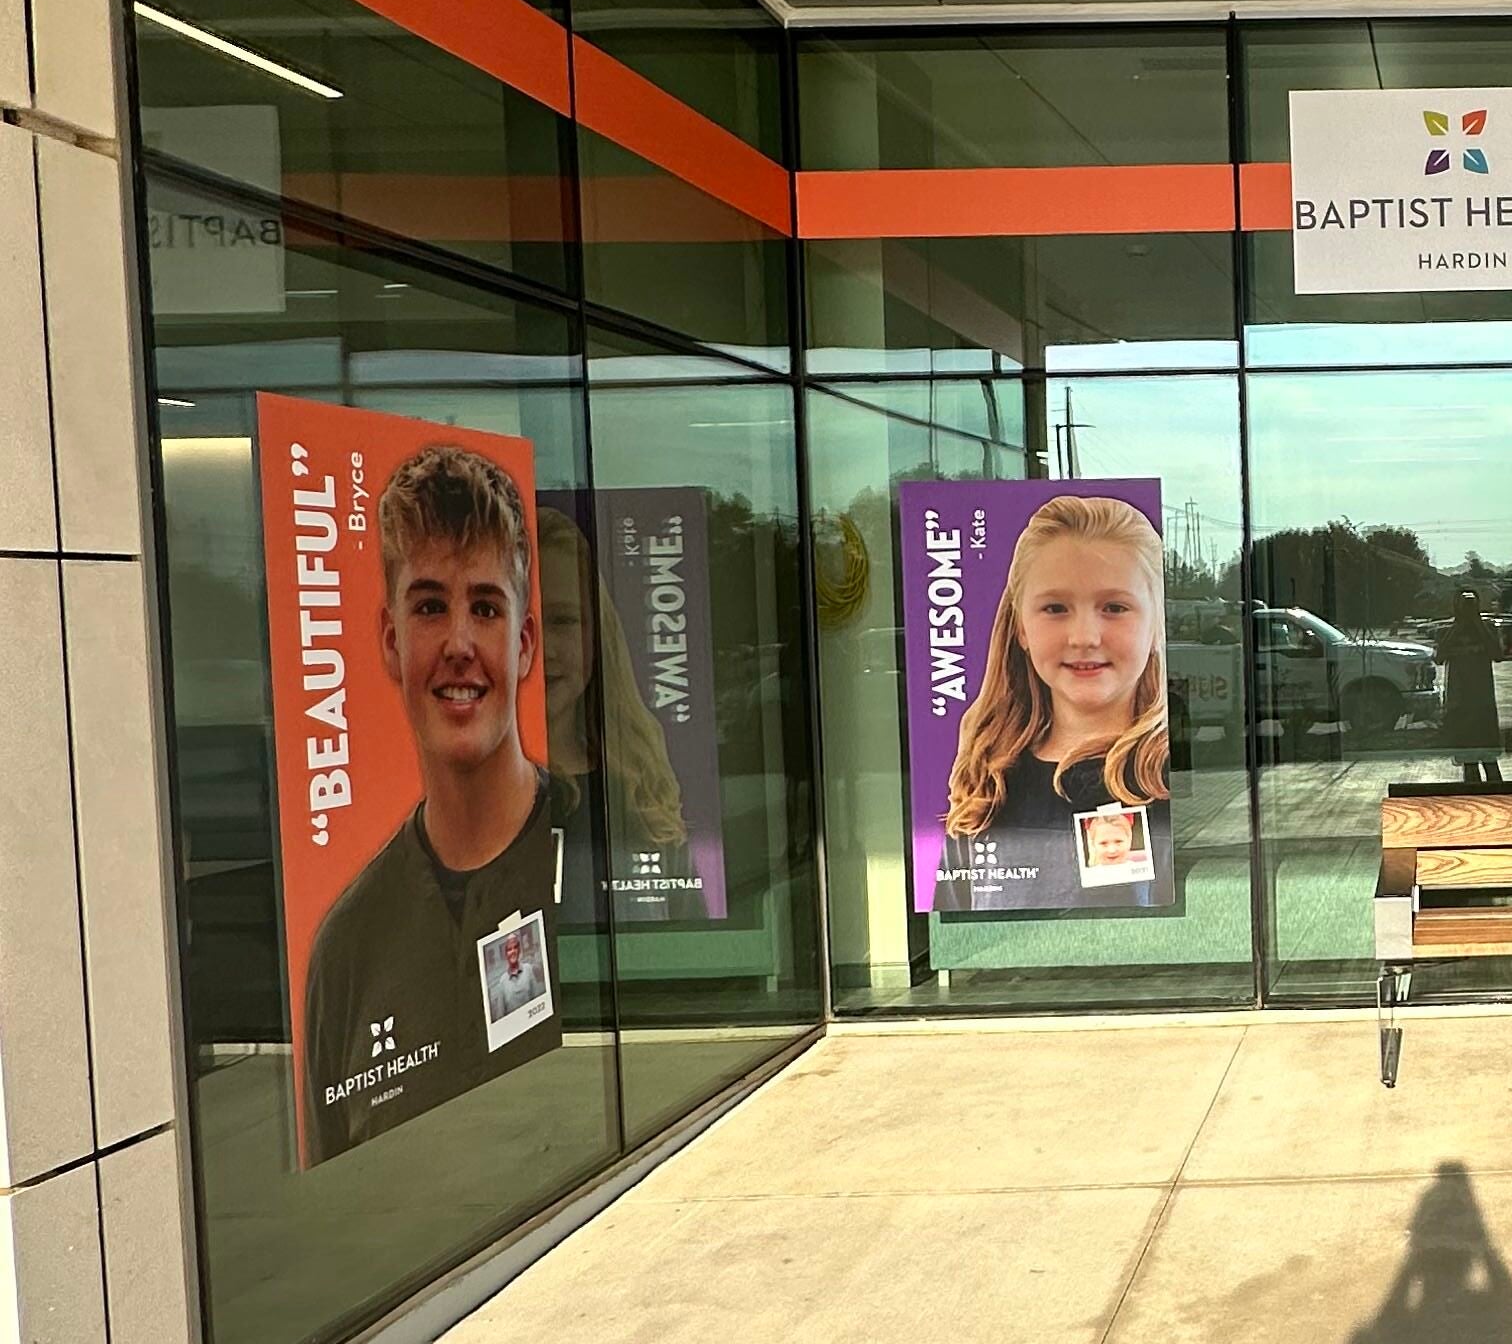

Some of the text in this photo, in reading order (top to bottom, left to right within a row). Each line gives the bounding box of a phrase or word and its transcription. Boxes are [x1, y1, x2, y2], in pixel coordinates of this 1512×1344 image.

[1295, 197, 1453, 230] BAPTIST
[1418, 252, 1508, 270] HARDIN
[348, 451, 370, 531] Bryce
[970, 509, 987, 549] Kate
[936, 866, 1037, 882] BAPTIST HEALTH
[325, 1041, 439, 1105] BAPTIST HEALTH
[371, 1084, 404, 1106] HARDIN
